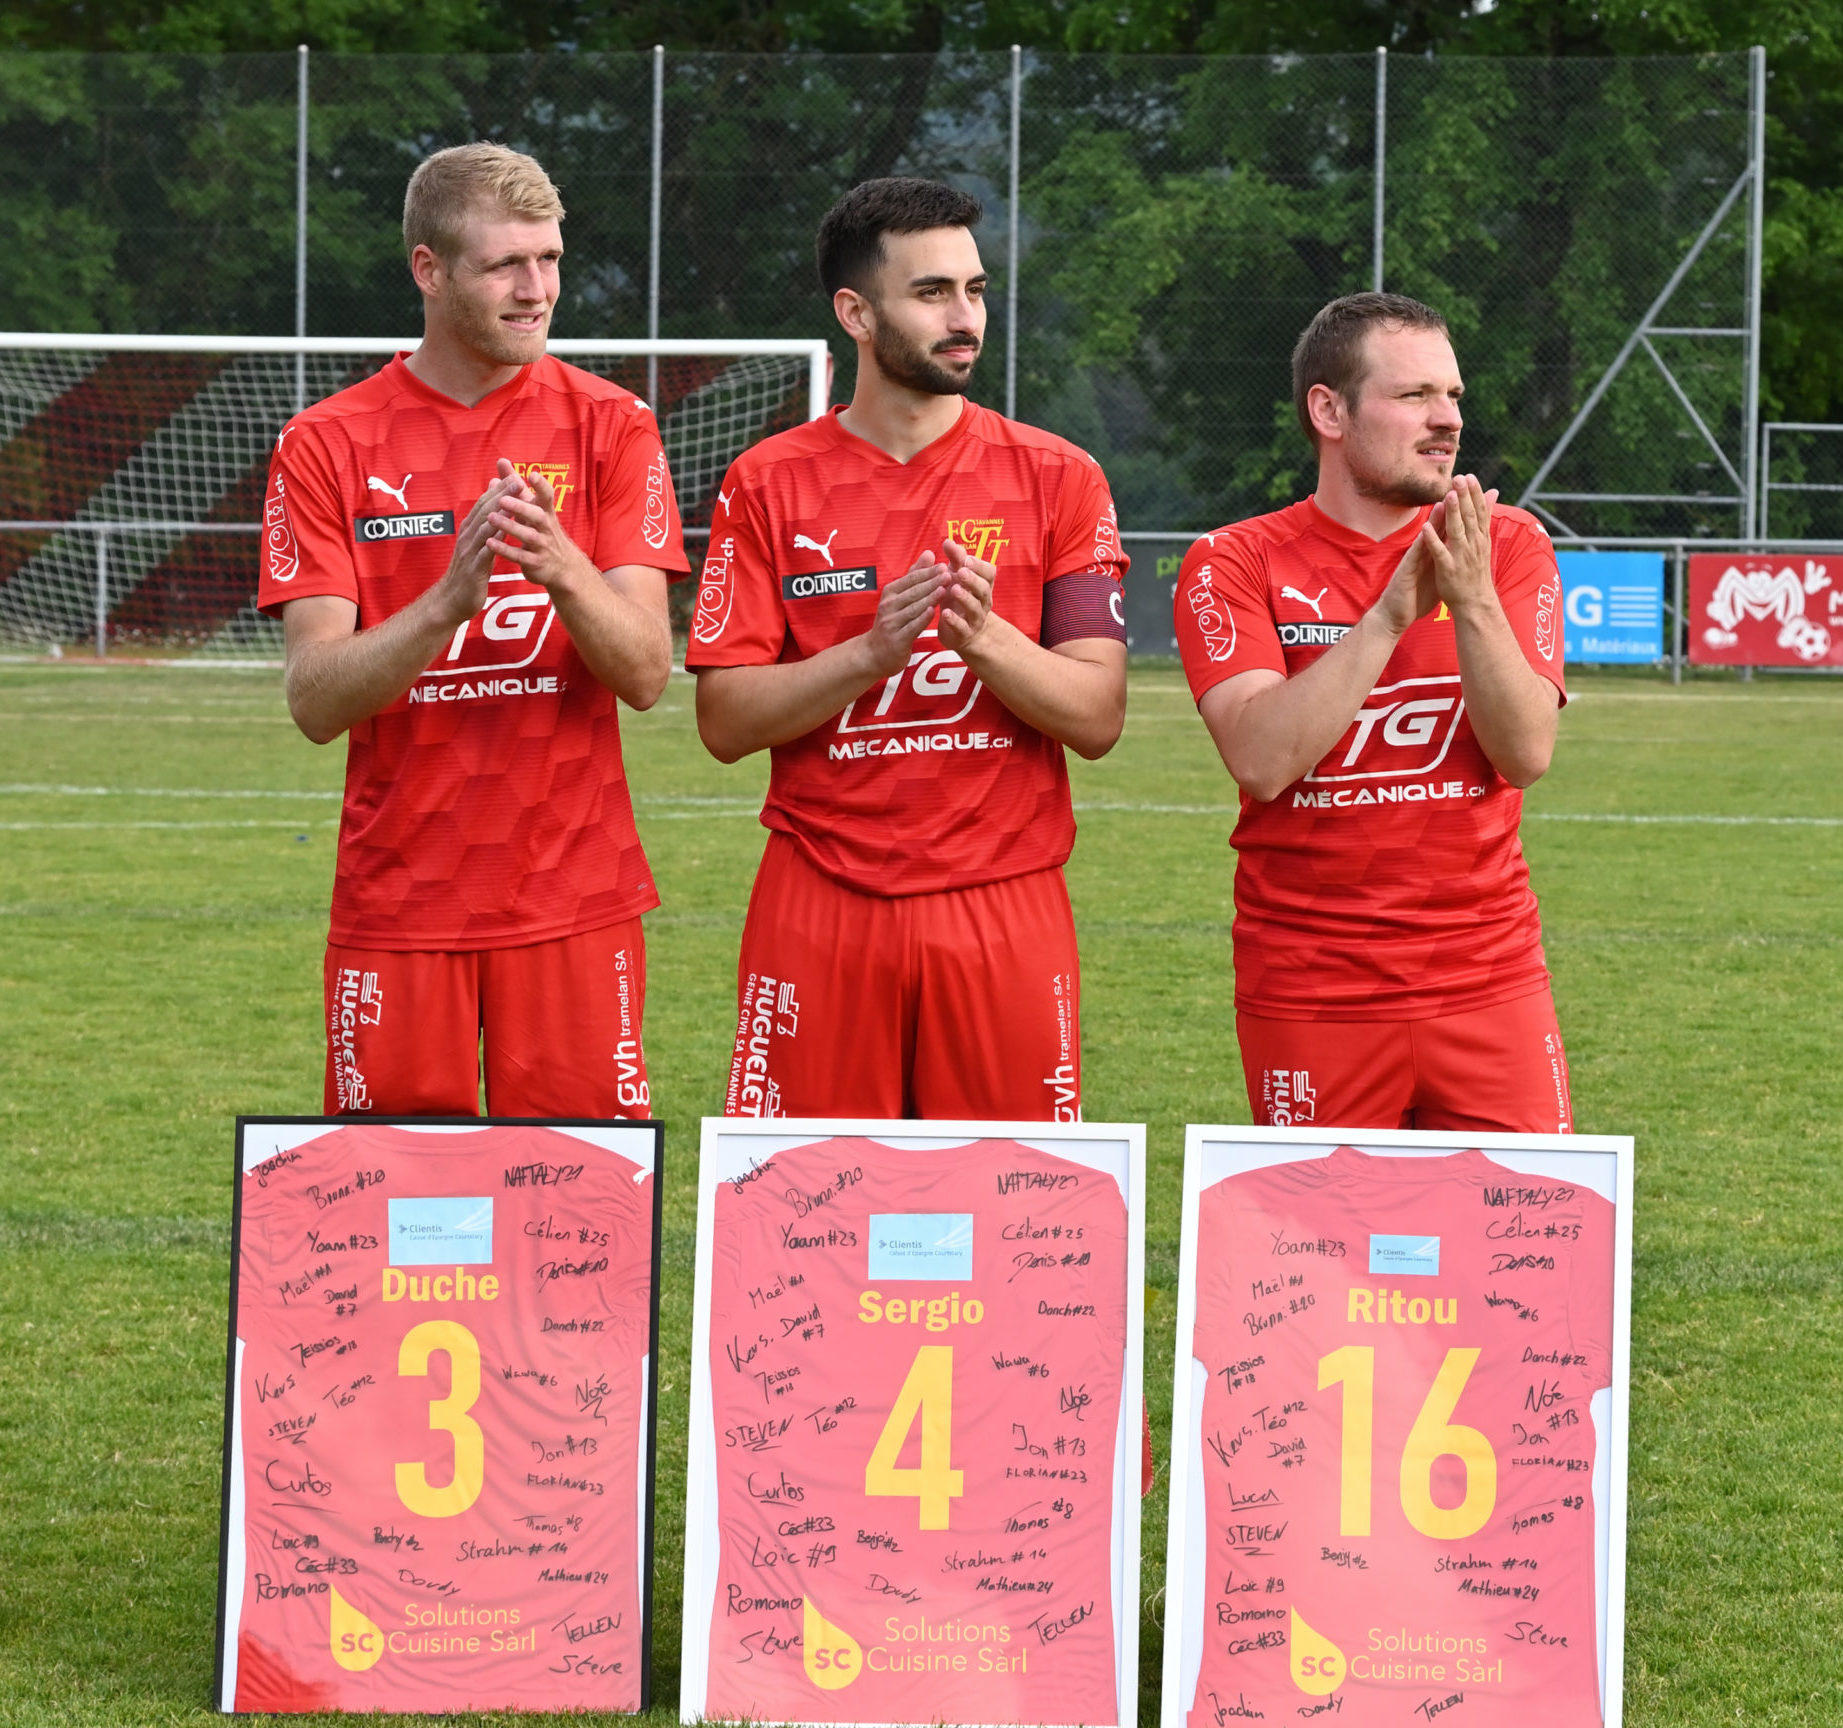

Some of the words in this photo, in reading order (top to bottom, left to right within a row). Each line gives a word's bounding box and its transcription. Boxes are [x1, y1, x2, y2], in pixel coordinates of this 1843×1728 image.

[617, 975, 631, 1036] tramelan
[382, 1266, 500, 1302] Duche
[858, 1290, 985, 1332] Sergio
[1347, 1287, 1458, 1325] Ritou
[395, 1320, 484, 1518] 3
[725, 1414, 795, 1447] STEVEN
[865, 1345, 964, 1530] 4
[1317, 1345, 1497, 1540] 16
[1225, 1520, 1289, 1546] STEVEN
[404, 1601, 521, 1627] Solutions
[340, 1632, 375, 1654] SC
[387, 1630, 481, 1654] Cuisine
[489, 1627, 536, 1653] Sàrl
[884, 1615, 1012, 1643] Solutions
[1367, 1627, 1488, 1654] Solutions
[1503, 1621, 1570, 1649] Steve
[548, 1653, 623, 1676] Steve
[814, 1648, 852, 1670] SC
[866, 1647, 968, 1674] Cuisine
[977, 1647, 1028, 1673] Sàrl
[1300, 1655, 1337, 1678] SC
[1350, 1655, 1446, 1680] Cuisine
[1455, 1657, 1503, 1683] Sàrl
